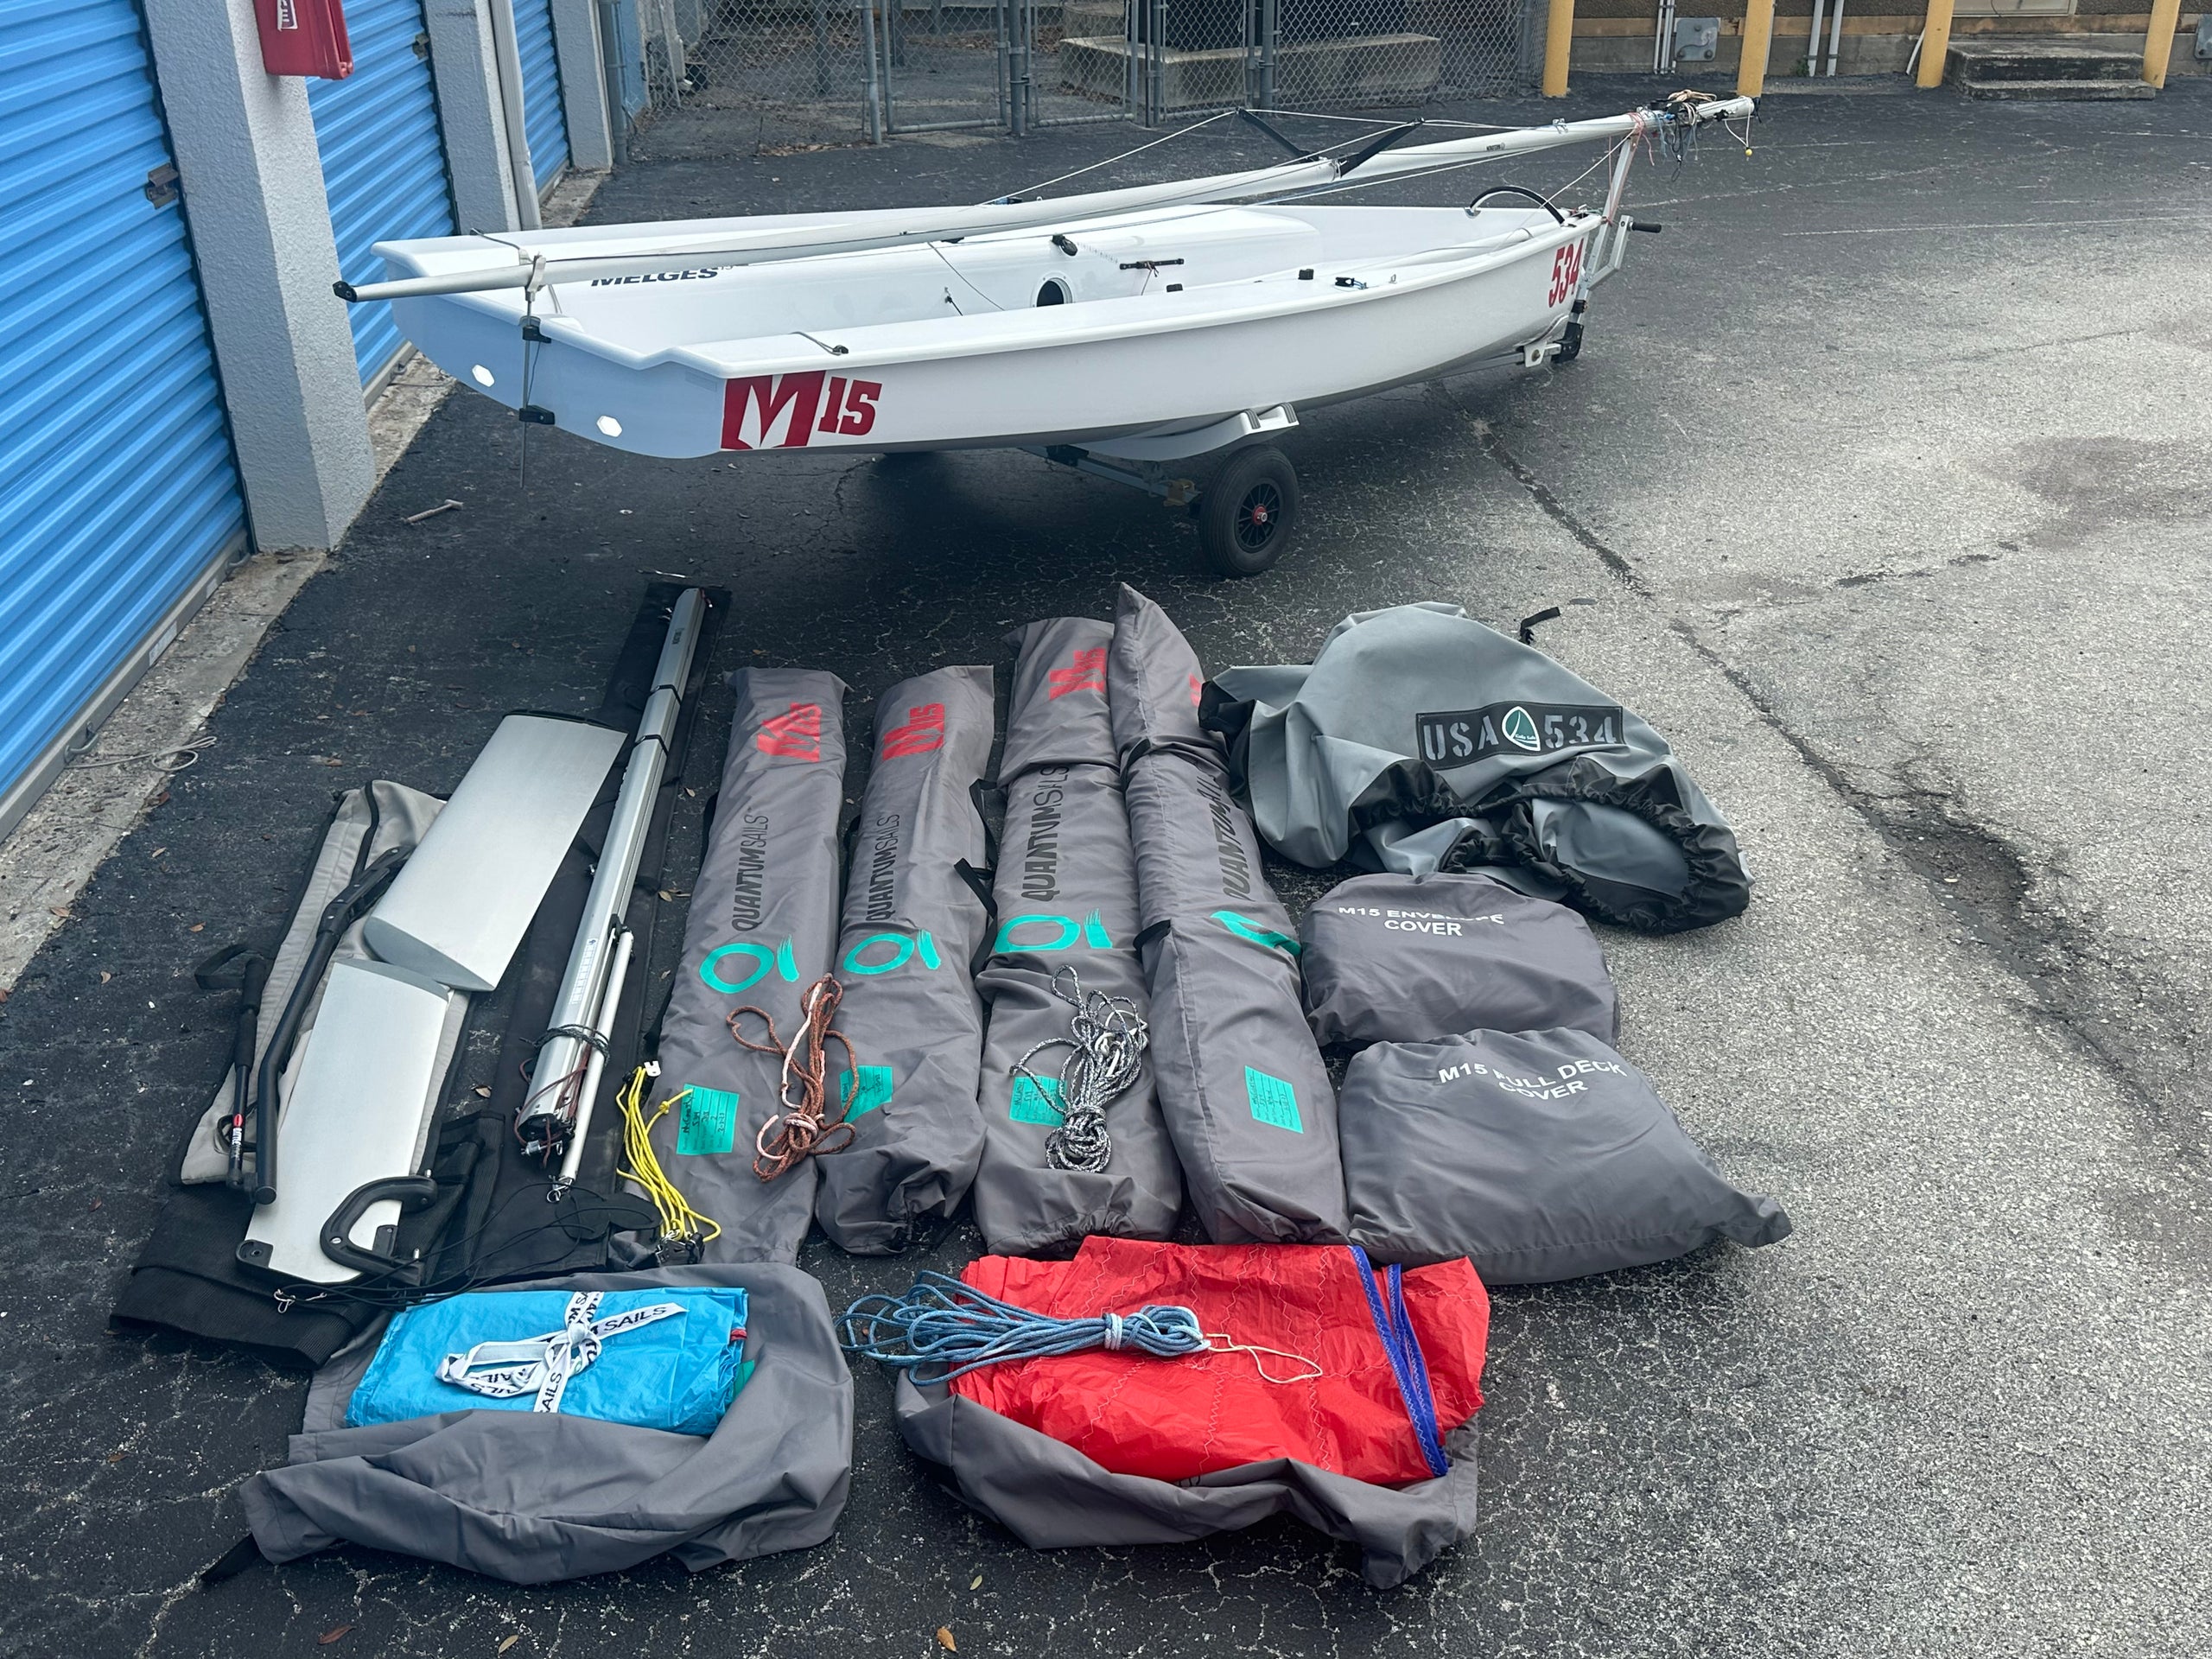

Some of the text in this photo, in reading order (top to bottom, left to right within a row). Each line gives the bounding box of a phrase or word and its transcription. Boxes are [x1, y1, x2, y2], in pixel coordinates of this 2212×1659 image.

[1548, 238, 1585, 308] 534
[721, 370, 882, 449] M15
[1423, 714, 1617, 760] USA 534
[1338, 907, 1381, 917] M15
[1384, 920, 1463, 937] COVER
[1438, 1062, 1488, 1083] M15
[1498, 1080, 1588, 1100] COVER
[605, 1306, 667, 1331] SAILS
[540, 1372, 563, 1413] AILS
